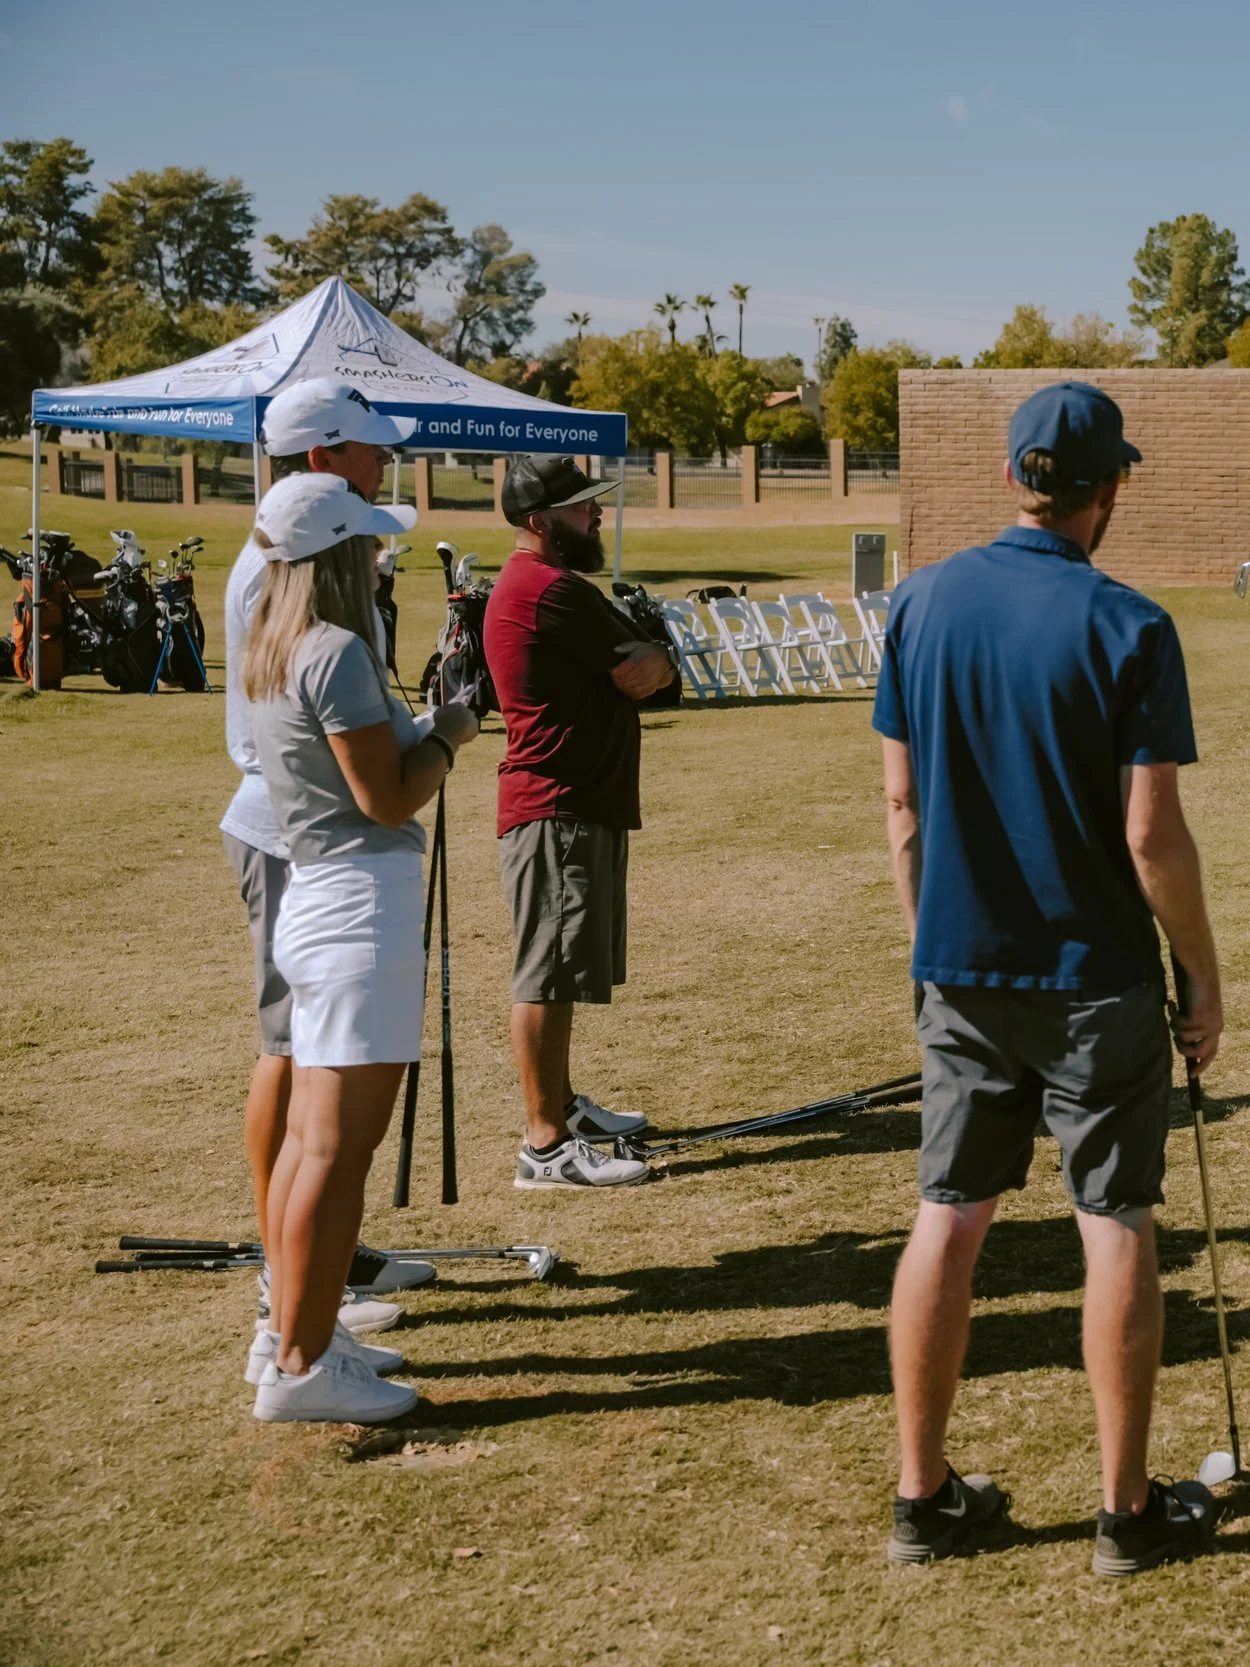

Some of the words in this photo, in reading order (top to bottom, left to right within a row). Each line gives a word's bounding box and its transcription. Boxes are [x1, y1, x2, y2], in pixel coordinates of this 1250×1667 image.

[184, 406, 235, 429] Everyone
[428, 418, 462, 435] and
[467, 419, 495, 436] Fun
[499, 420, 521, 438] for
[525, 422, 599, 444] Everyone
